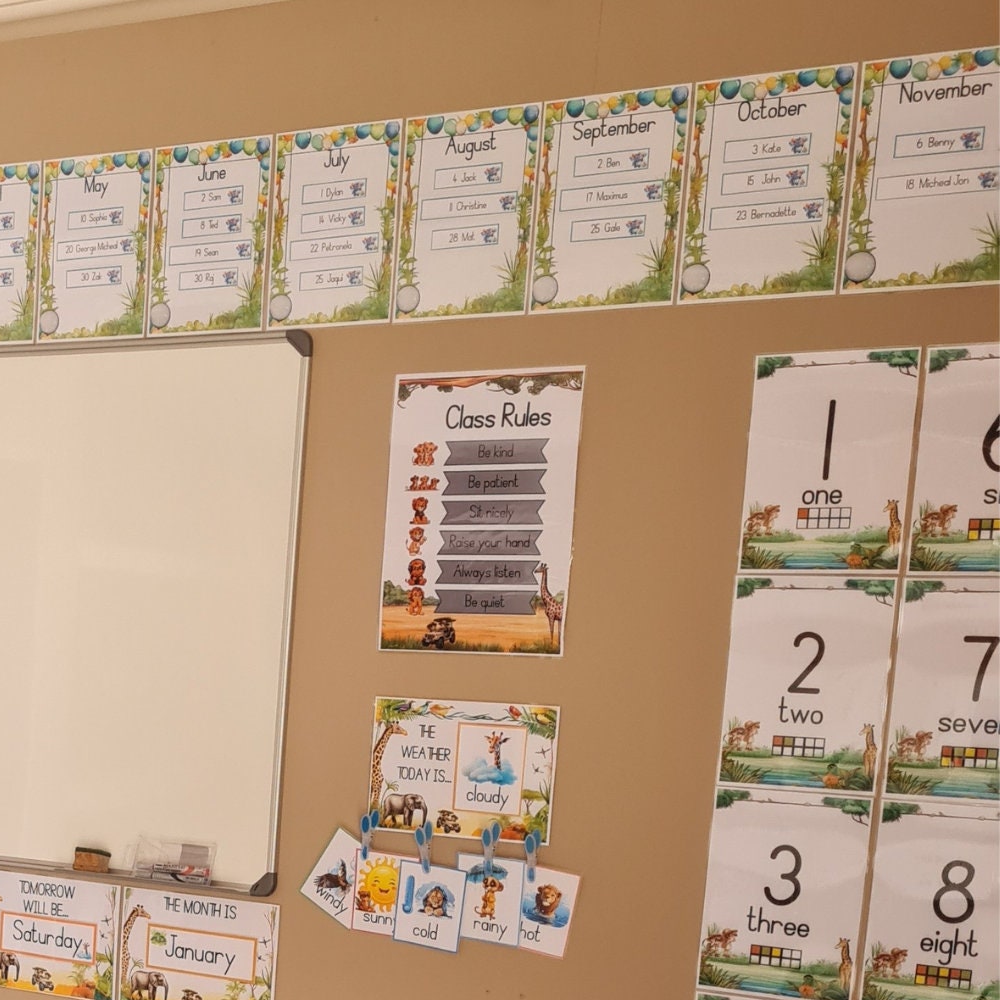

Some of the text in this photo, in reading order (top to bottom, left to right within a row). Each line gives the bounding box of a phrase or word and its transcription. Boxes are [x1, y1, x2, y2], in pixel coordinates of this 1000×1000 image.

[899, 76, 993, 105] November
[737, 97, 807, 122] October
[572, 115, 657, 146] September
[445, 132, 497, 160] August
[752, 143, 782, 155] 3 Kate
[916, 136, 956, 151] 6 Benny
[323, 150, 350, 174] July
[597, 157, 621, 168] 2 Ben
[198, 164, 226, 181] June
[461, 172, 477, 183] Jack
[747, 174, 781, 186] 15 John
[84, 176, 109, 199] May
[905, 176, 970, 190] 18 Micheal Jon
[201, 193, 206, 202] 2
[326, 187, 344, 199] Dylan
[586, 191, 629, 202] 17 Maximus
[456, 200, 487, 211] Christine
[736, 207, 797, 221] 23 Bernadette
[590, 222, 621, 234] 25 Gale
[449, 233, 459, 243] 28
[446, 401, 552, 429] Class Rules
[821, 399, 836, 481] 1
[477, 445, 514, 459] Be kind
[468, 474, 520, 493] Be patient
[801, 487, 843, 505] one
[469, 504, 514, 523] Sit nicely
[449, 534, 531, 552] Raise your hand
[453, 564, 521, 584] Always listen
[464, 594, 505, 612] Be quiet
[787, 631, 826, 695] 2
[963, 634, 1000, 703] 7
[777, 695, 824, 725] two
[419, 723, 437, 738] THE
[937, 716, 1000, 735] seve
[401, 744, 451, 762] WEATHER
[396, 765, 431, 782] TODAY
[466, 784, 510, 811] cloudy
[763, 844, 802, 907] 3
[18, 879, 76, 900] TOMORROW
[932, 859, 976, 925] 8
[23, 899, 49, 914] WILL
[163, 896, 238, 920] THE MONTH IS
[315, 885, 348, 916] windy
[363, 912, 396, 932] sunn
[412, 922, 438, 941] cold
[473, 918, 508, 941] rainy
[520, 920, 542, 943] hot
[746, 905, 810, 939] three
[12, 918, 83, 958] Saturday
[919, 927, 979, 966] eight
[164, 933, 237, 976] January
